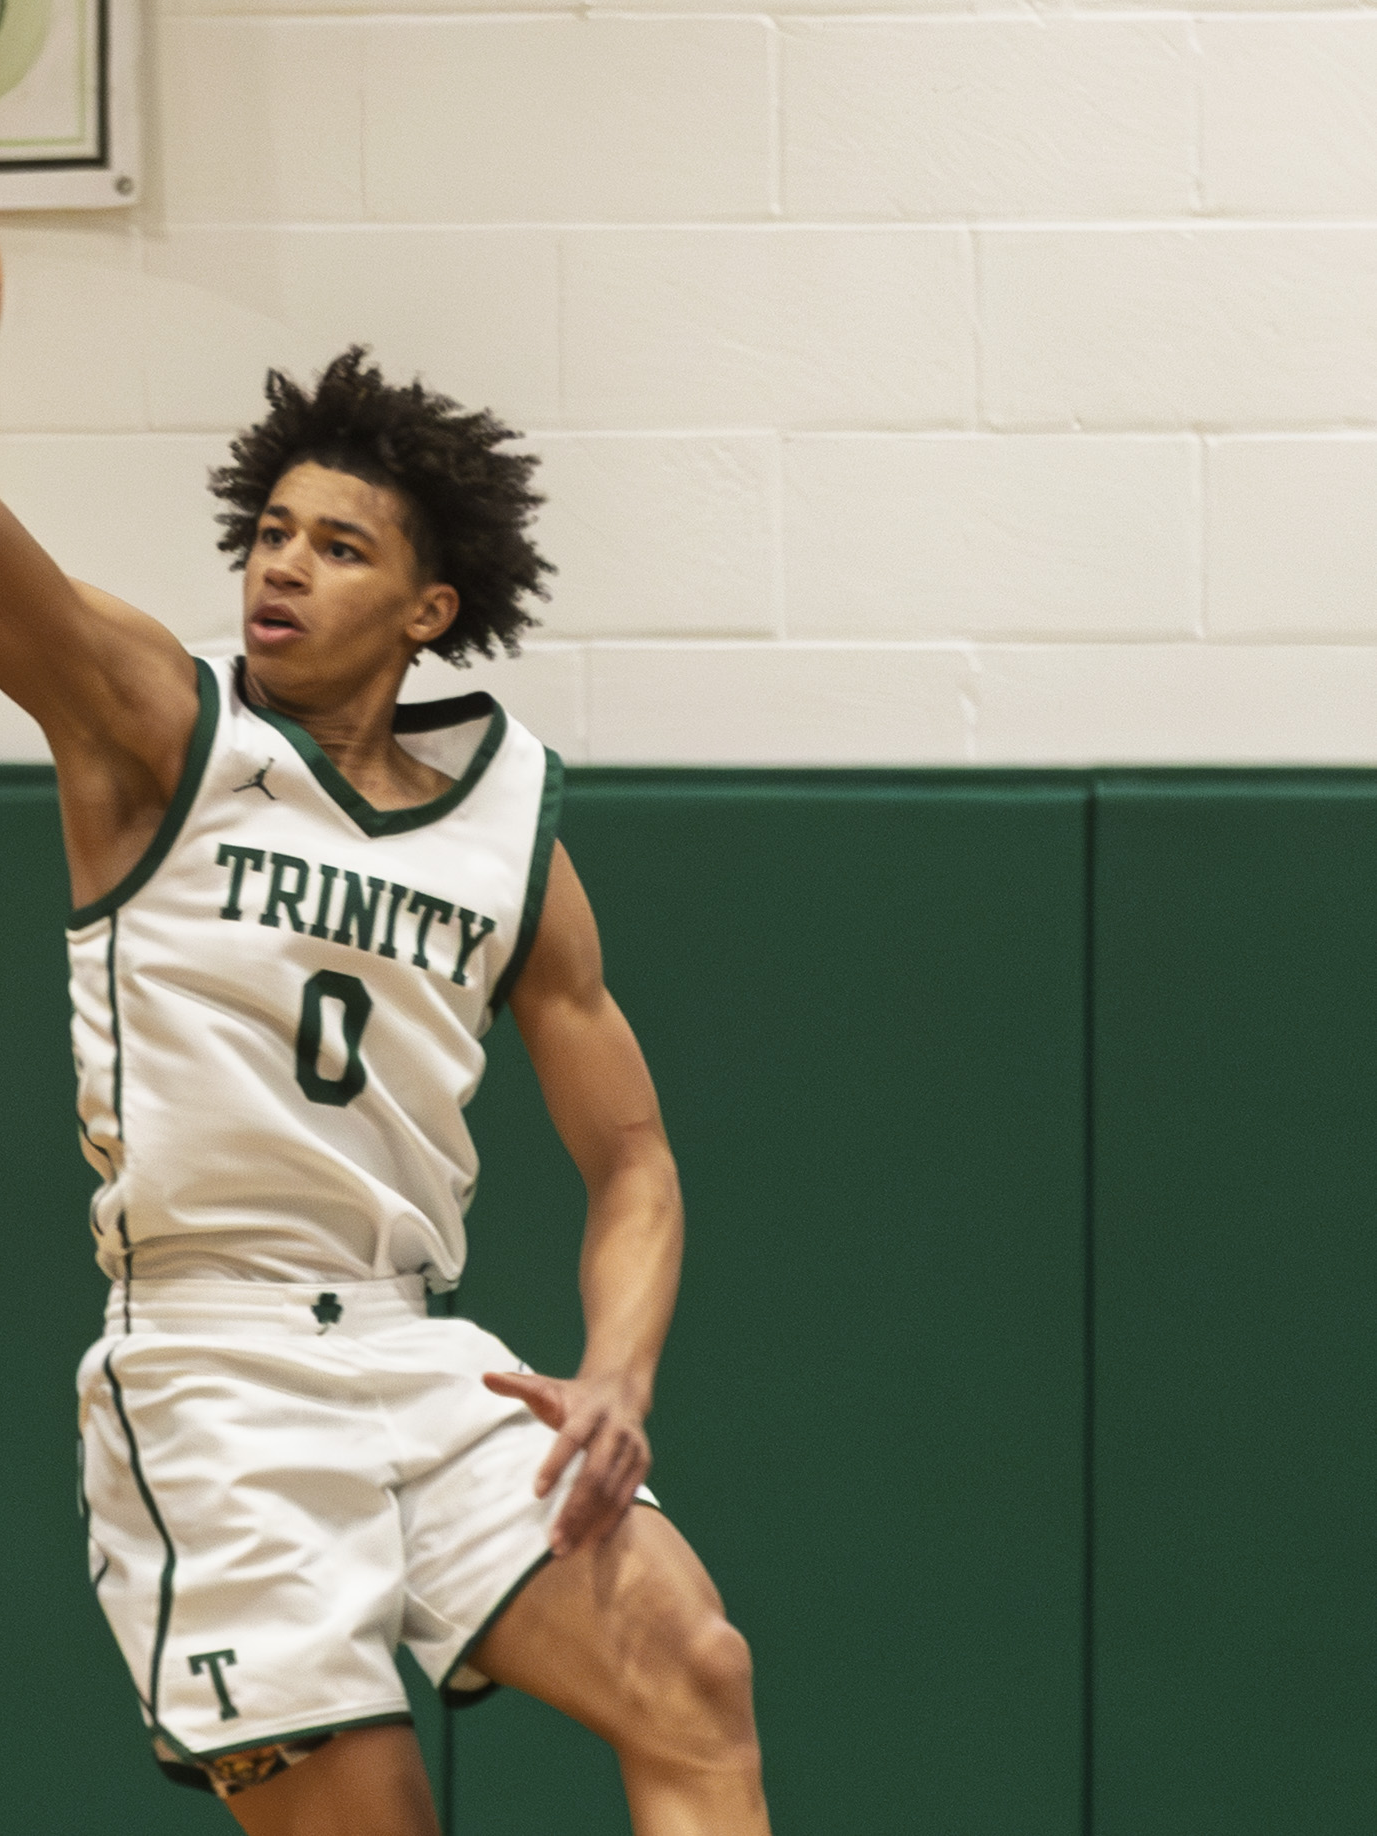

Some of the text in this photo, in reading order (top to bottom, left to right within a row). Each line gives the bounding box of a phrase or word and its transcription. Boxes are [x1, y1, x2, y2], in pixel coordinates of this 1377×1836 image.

[216, 843, 496, 986] TRINITY
[295, 969, 373, 1107] 0
[188, 1648, 240, 1722] T
